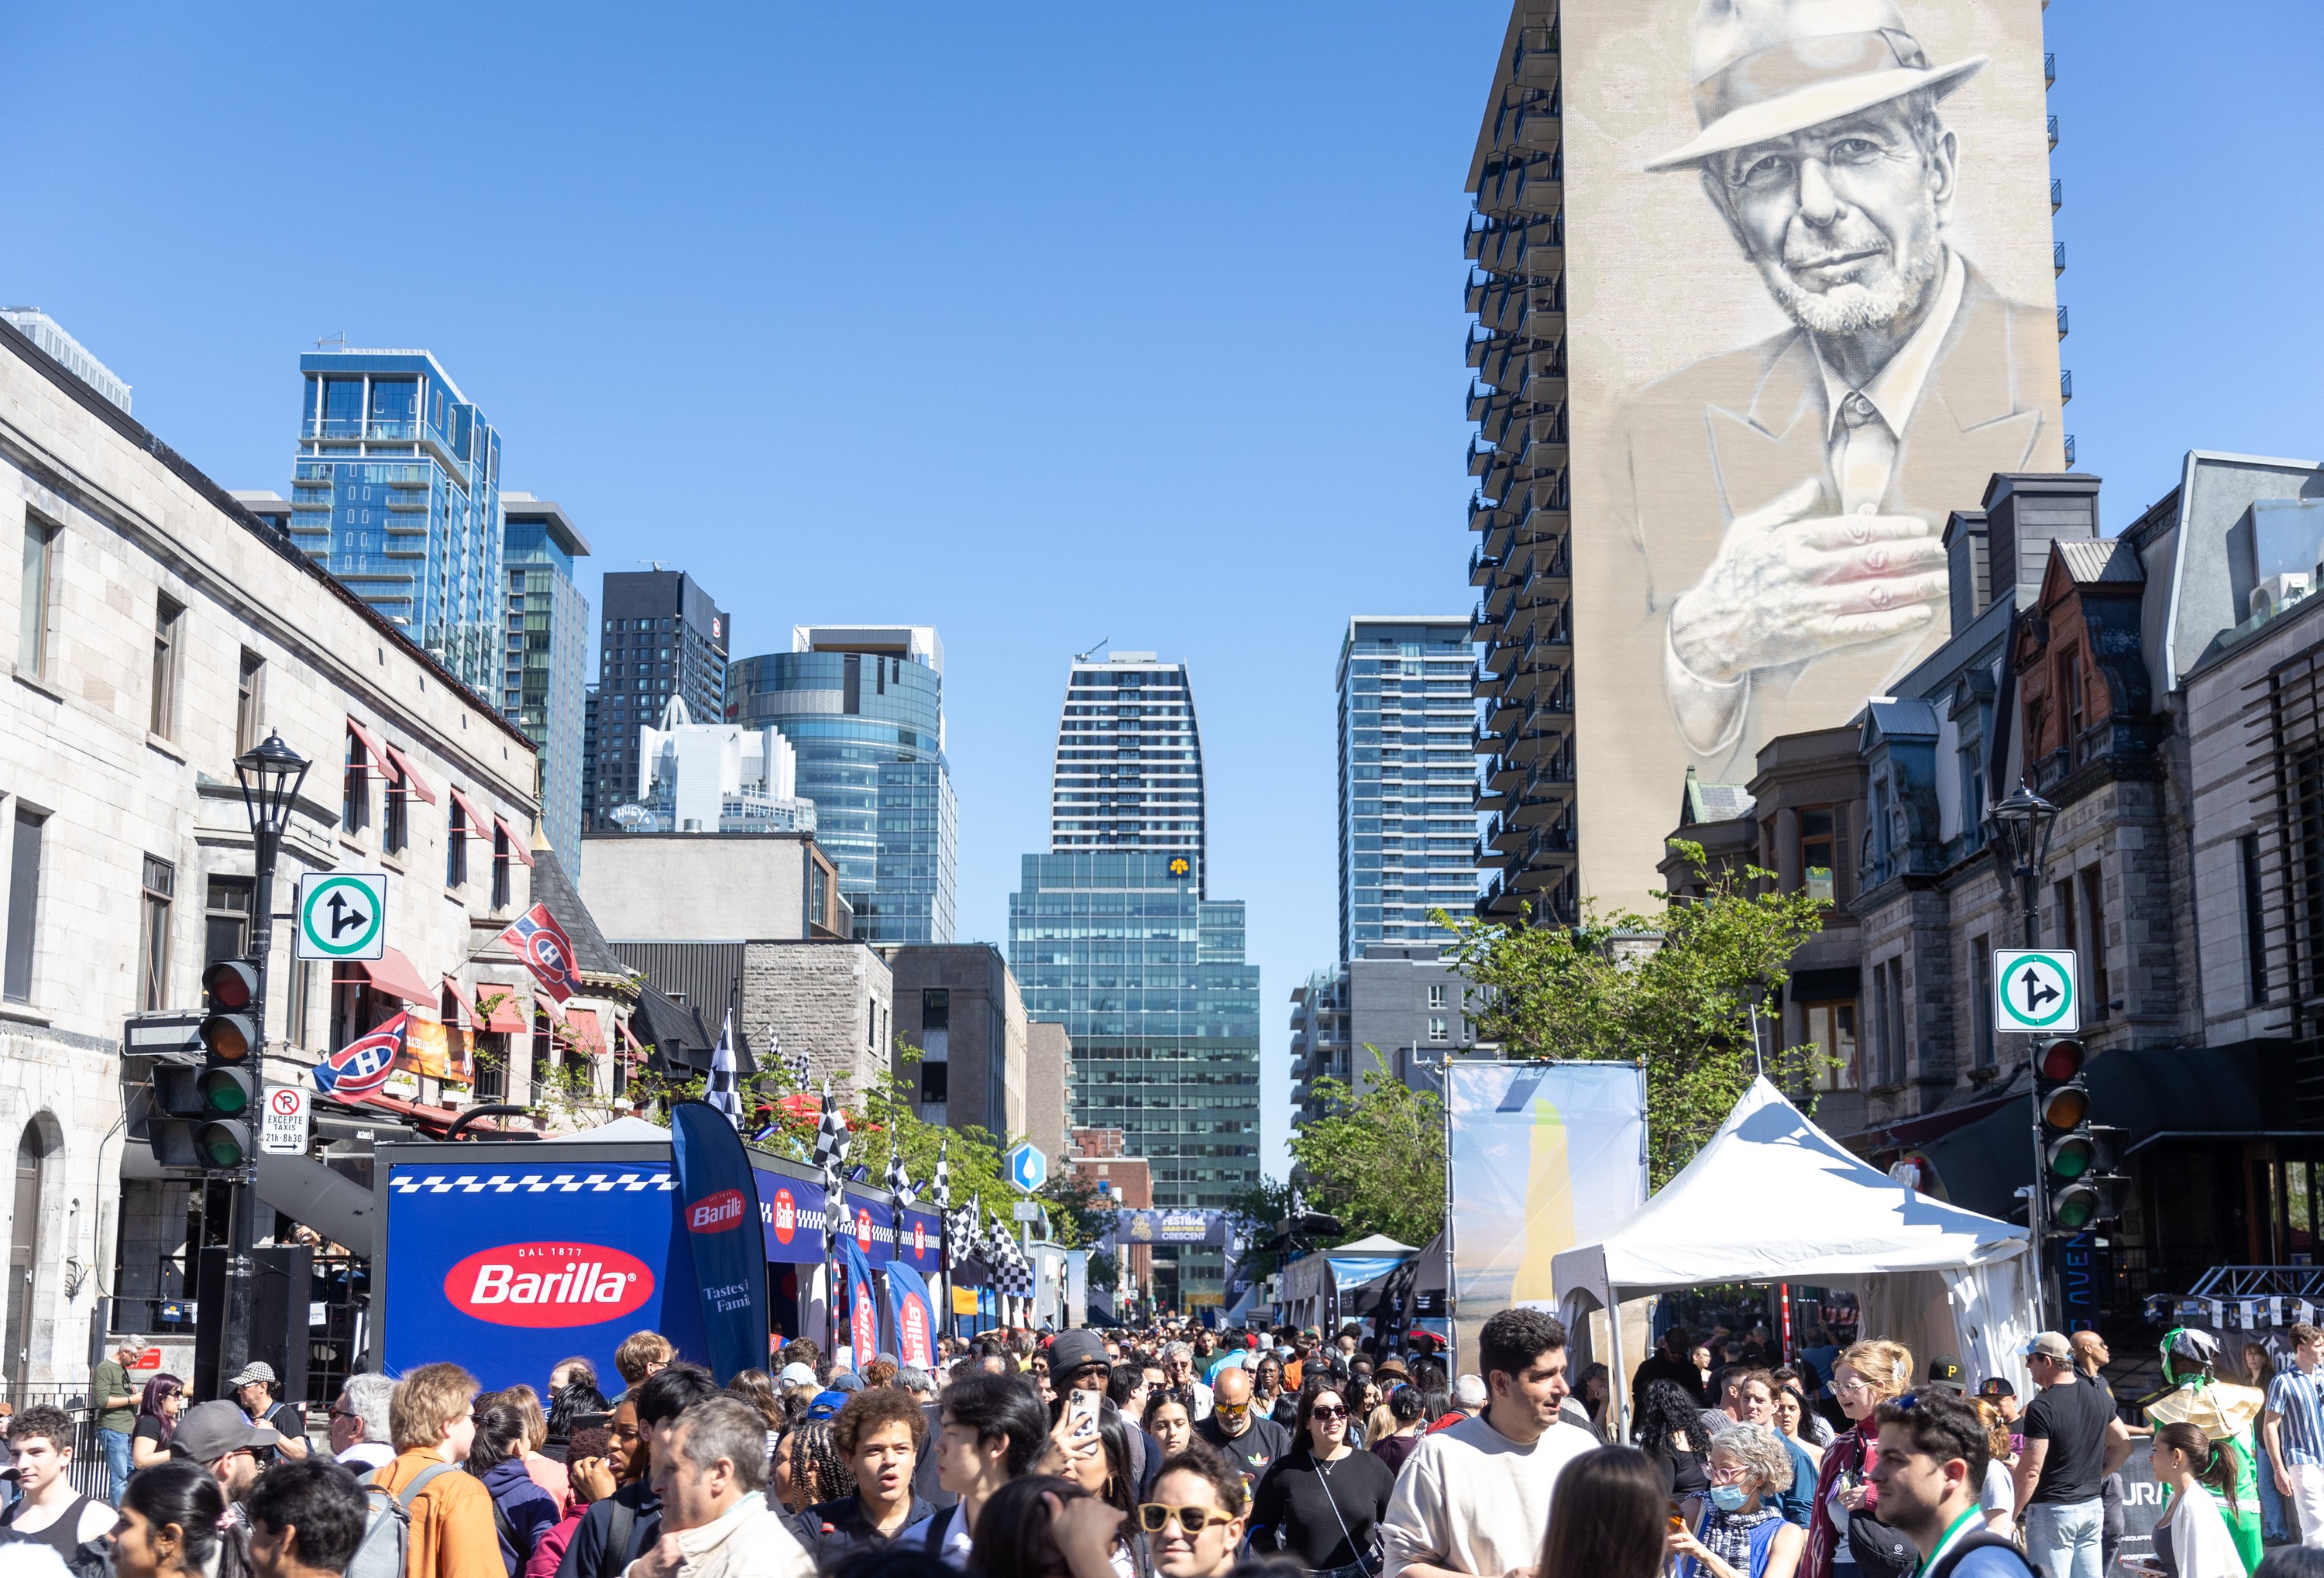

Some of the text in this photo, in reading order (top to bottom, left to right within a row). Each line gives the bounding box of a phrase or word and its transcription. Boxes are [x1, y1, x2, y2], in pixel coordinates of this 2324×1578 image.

[268, 1115, 303, 1124] EXCEPTE
[693, 1196, 742, 1228] Barilla
[1161, 1232, 1206, 1240] CRESCENT
[518, 1247, 583, 1257] DAL 1877
[703, 1283, 744, 1300] Tastes
[1948, 1365, 1958, 1377] P
